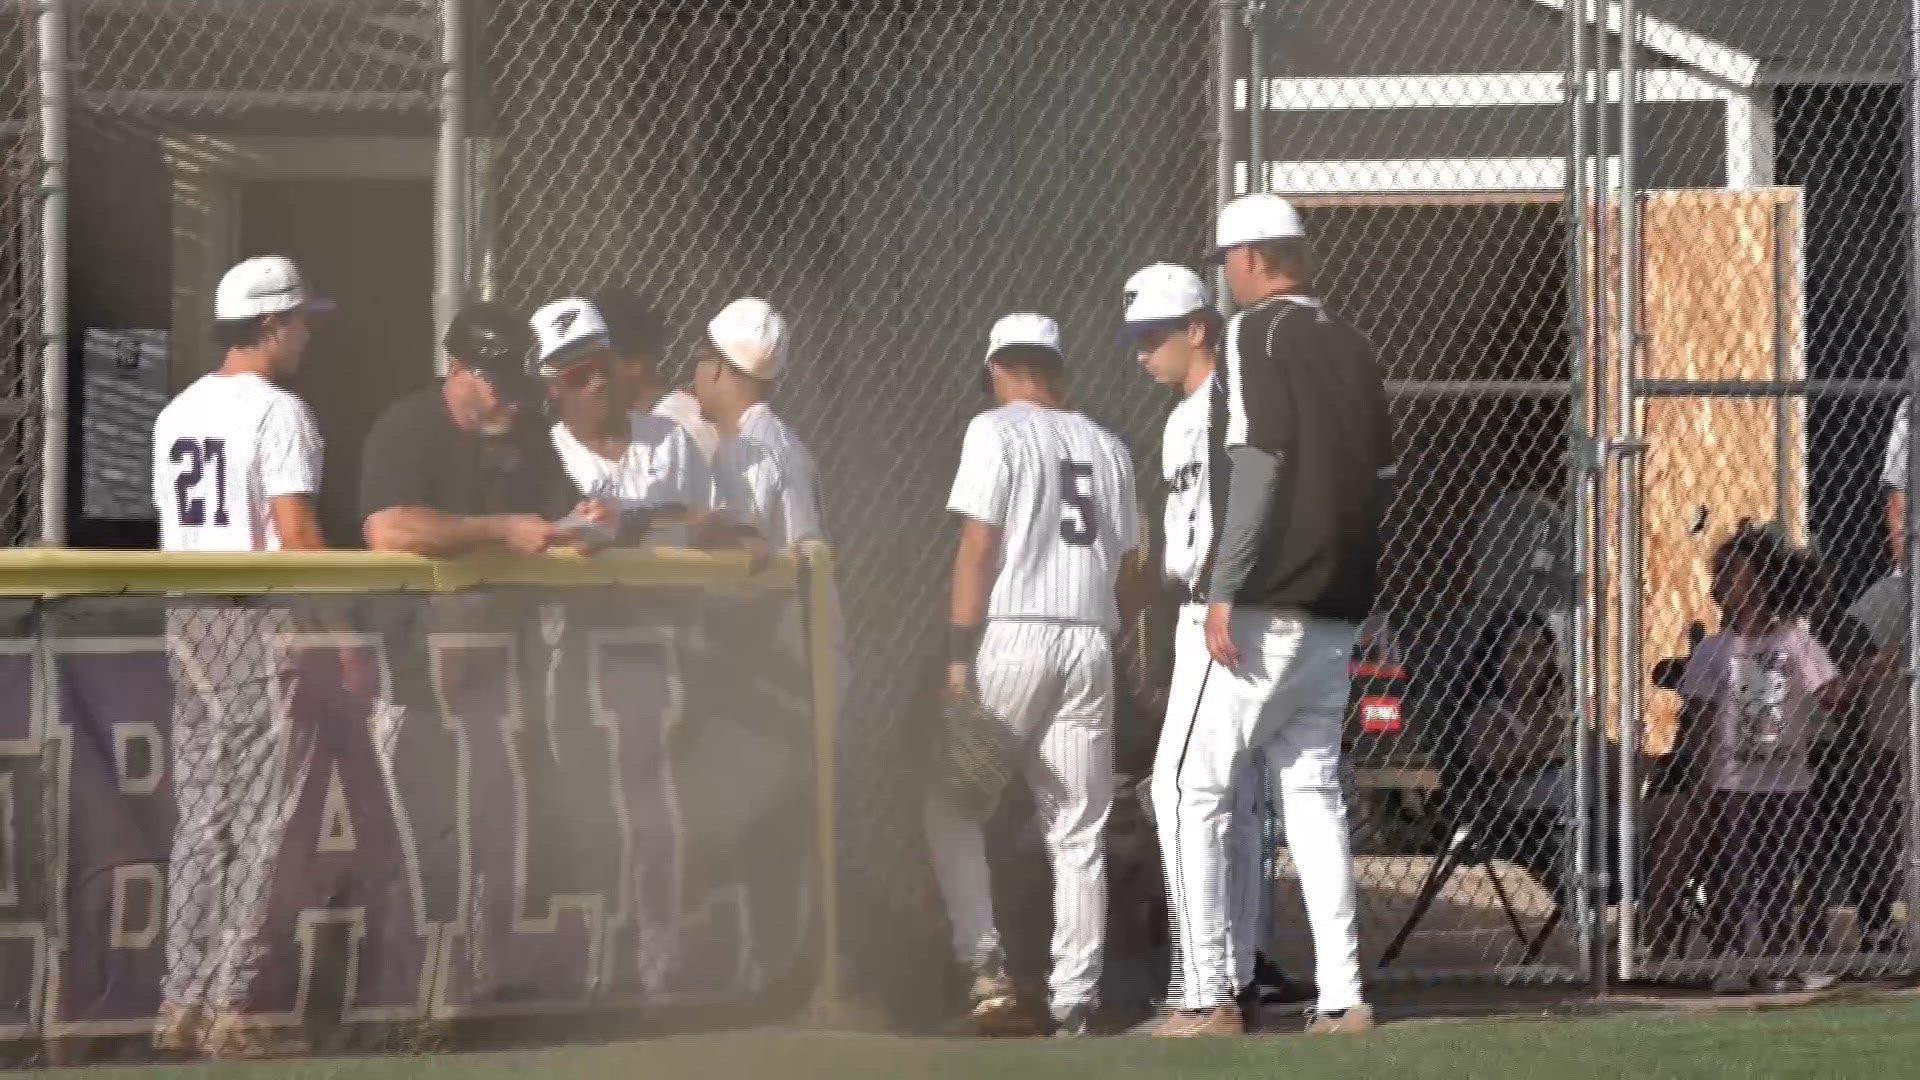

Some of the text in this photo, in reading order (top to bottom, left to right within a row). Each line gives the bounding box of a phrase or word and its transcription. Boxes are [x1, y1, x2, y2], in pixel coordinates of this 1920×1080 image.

[169, 437, 231, 526] 27
[1059, 460, 1099, 547] 5
[0, 628, 755, 1042] BALL
